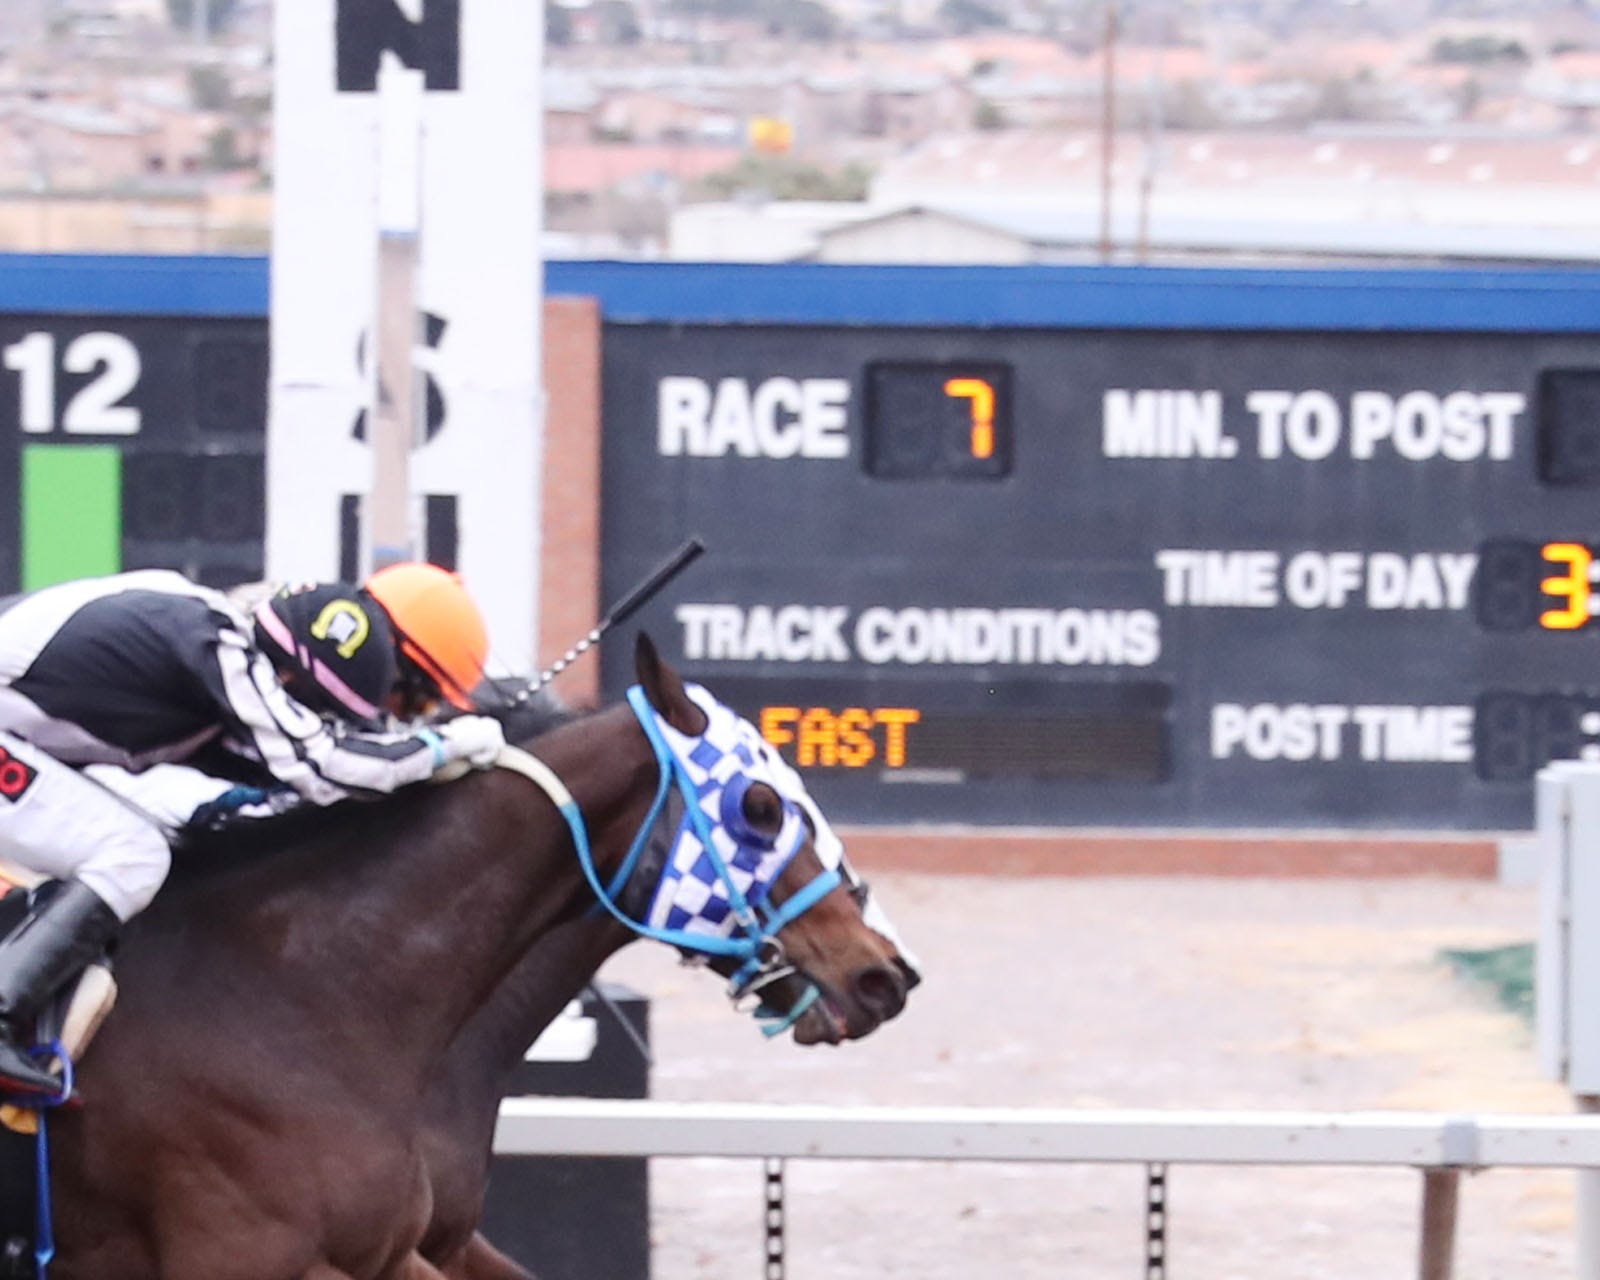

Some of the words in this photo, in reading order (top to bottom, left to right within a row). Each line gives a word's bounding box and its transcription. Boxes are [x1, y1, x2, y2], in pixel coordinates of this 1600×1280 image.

[3, 331, 141, 436] 12
[658, 375, 851, 459] RACE
[942, 378, 996, 460] 7
[1102, 388, 1239, 459] MIN.
[1245, 389, 1341, 462] TO
[1349, 389, 1526, 462] POST
[1155, 550, 1281, 608] TIME
[1286, 550, 1364, 609] OF
[1366, 552, 1479, 611] DAY
[676, 606, 849, 662] TRACK
[854, 608, 1161, 667] CONDITIONS
[759, 706, 921, 768] FAST
[1210, 703, 1349, 760] POST
[1351, 705, 1476, 762] TIME
